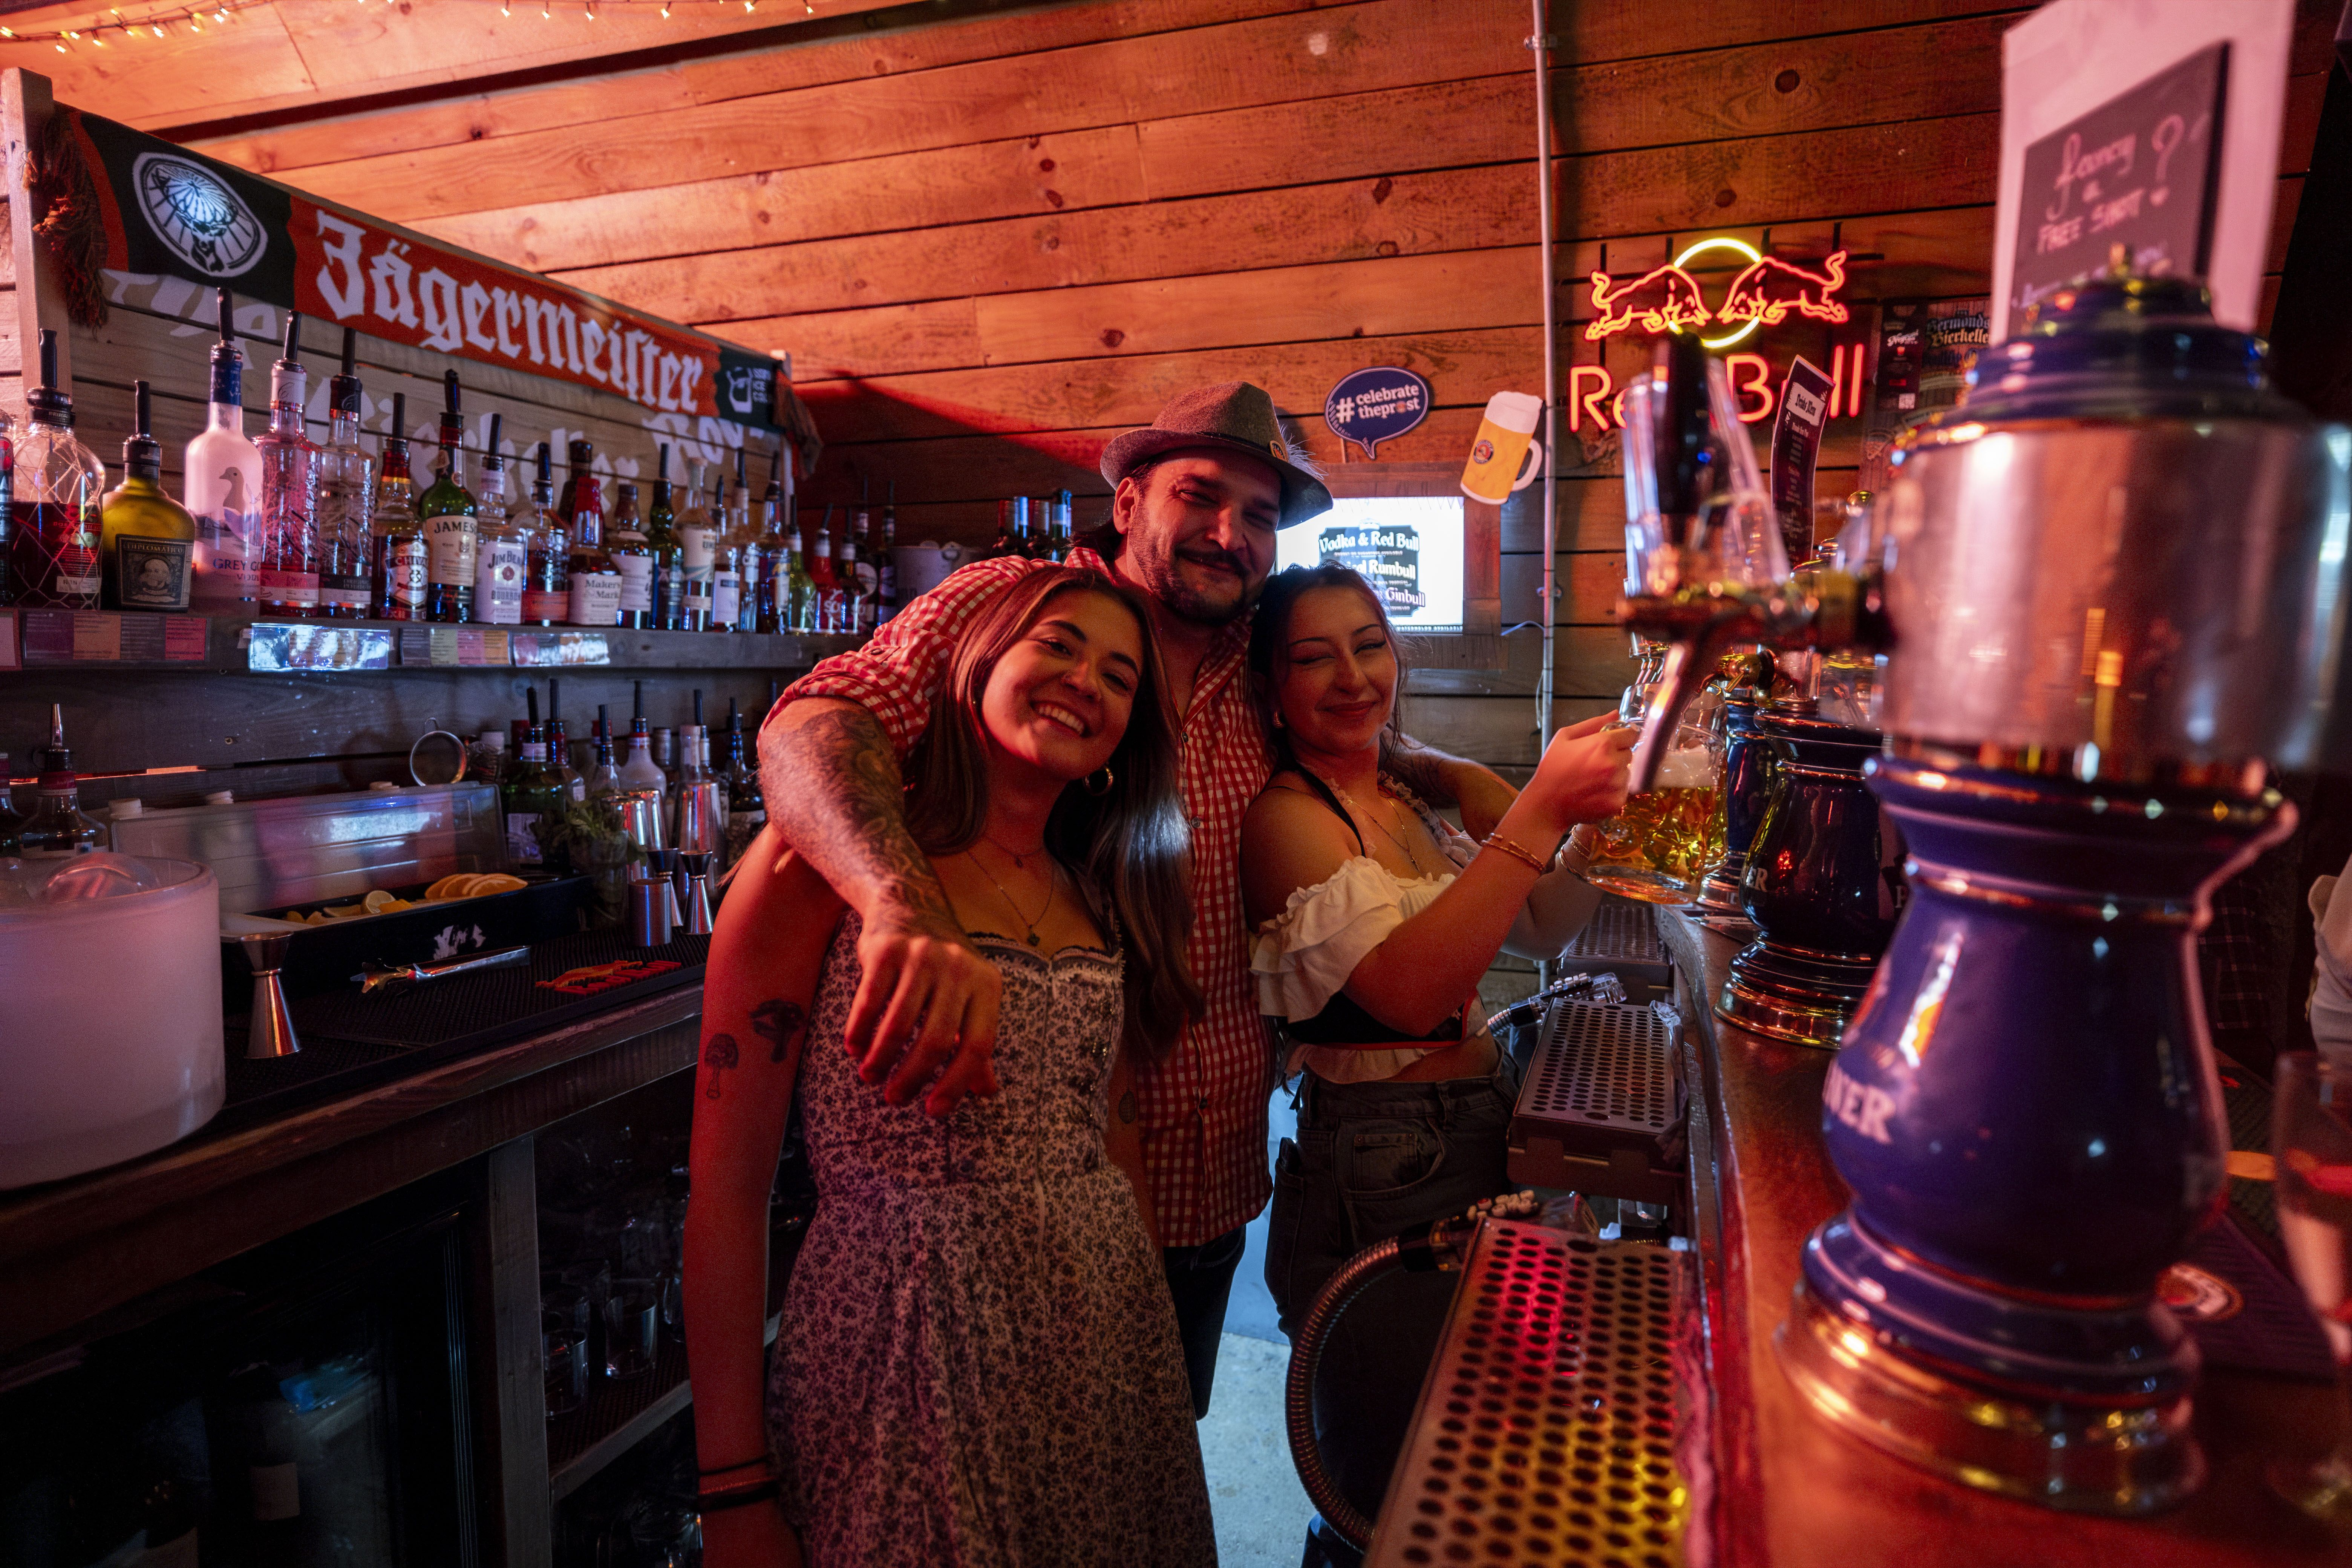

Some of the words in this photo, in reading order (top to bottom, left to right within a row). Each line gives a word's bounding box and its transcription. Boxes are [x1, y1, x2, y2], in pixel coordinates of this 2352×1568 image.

[2037, 216, 2084, 255] FREE
[2089, 187, 2145, 233] SHOT
[1927, 314, 1989, 333] Bermonds
[1931, 328, 1989, 347] Bierkelle
[1726, 344, 1864, 422] Bll
[434, 521, 476, 533] JAMES
[1319, 534, 1356, 553] Vodka
[1358, 533, 1369, 546] &
[1370, 531, 1394, 547] Red
[1396, 533, 1419, 551] Bull
[213, 558, 246, 570] GREY
[395, 556, 426, 566] CHIVA
[507, 550, 521, 565] BEA
[1369, 560, 1416, 580] Rumbull
[1386, 587, 1426, 607] Ginbull
